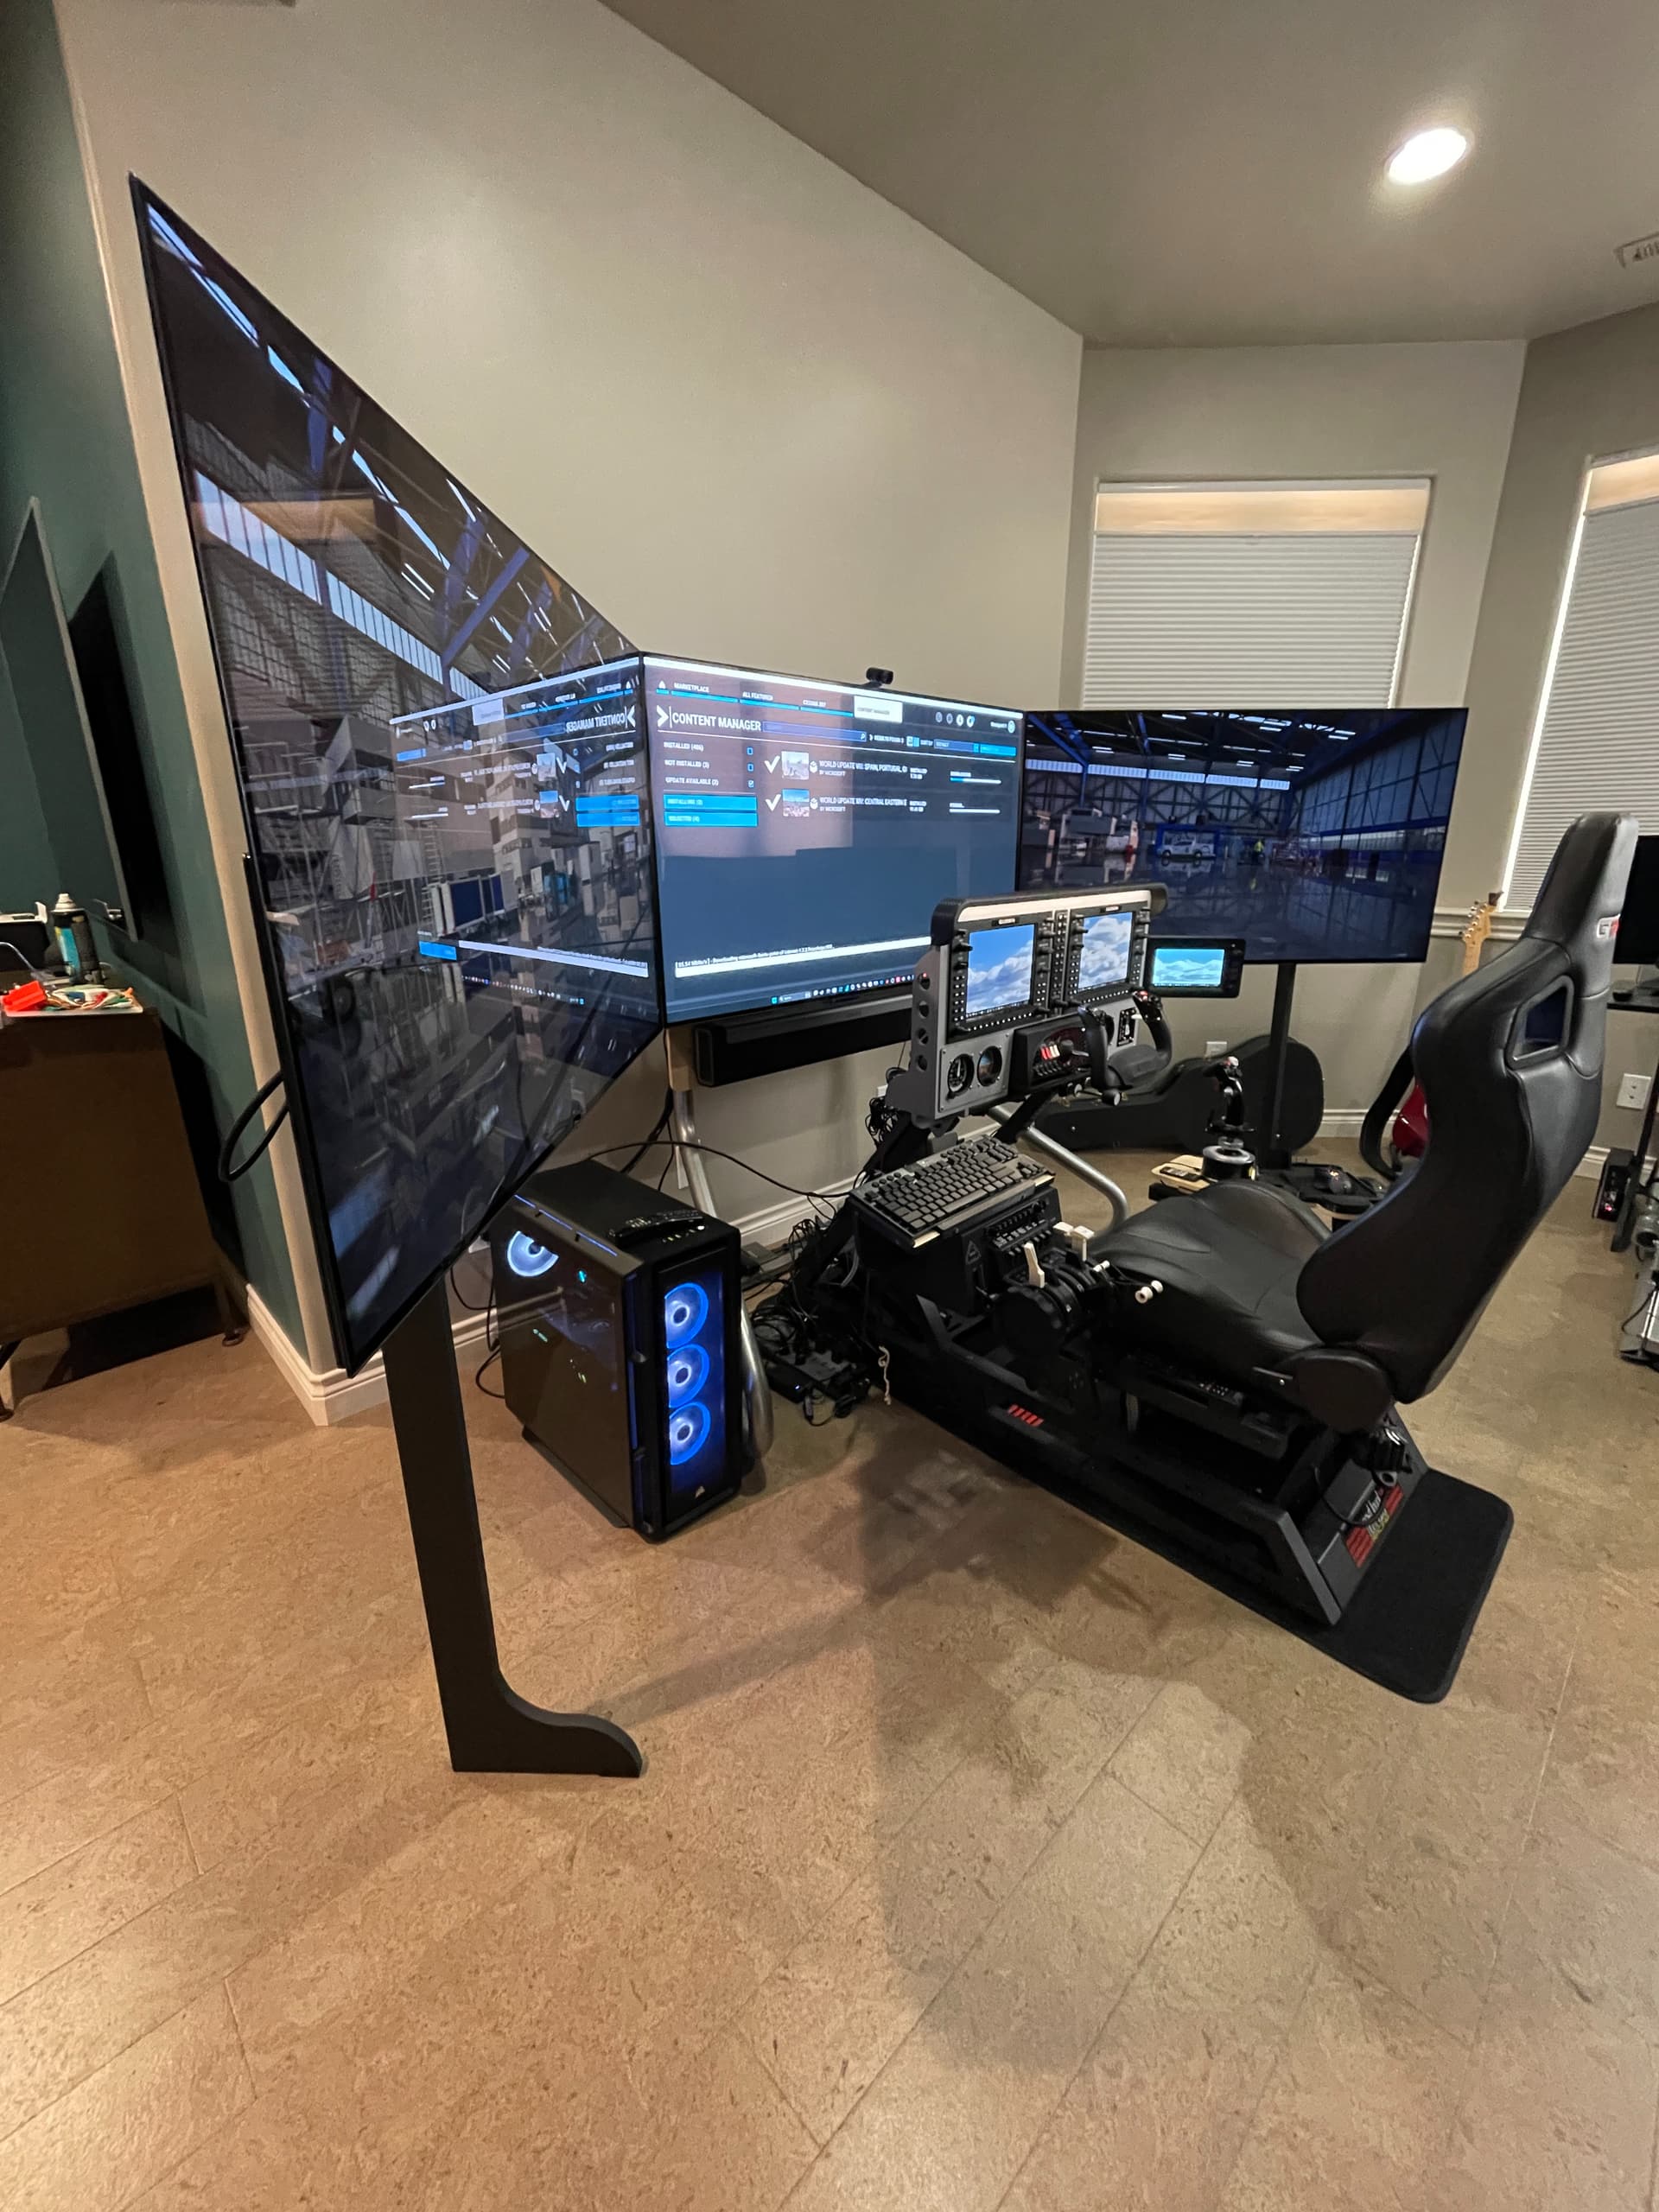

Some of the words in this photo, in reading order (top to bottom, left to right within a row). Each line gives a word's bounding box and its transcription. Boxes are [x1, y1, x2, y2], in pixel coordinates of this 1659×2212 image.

[672, 712, 716, 727] CONTENT
[717, 716, 761, 731] MANAGER
[819, 760, 836, 768] WORLD
[837, 760, 855, 769] UPDATE
